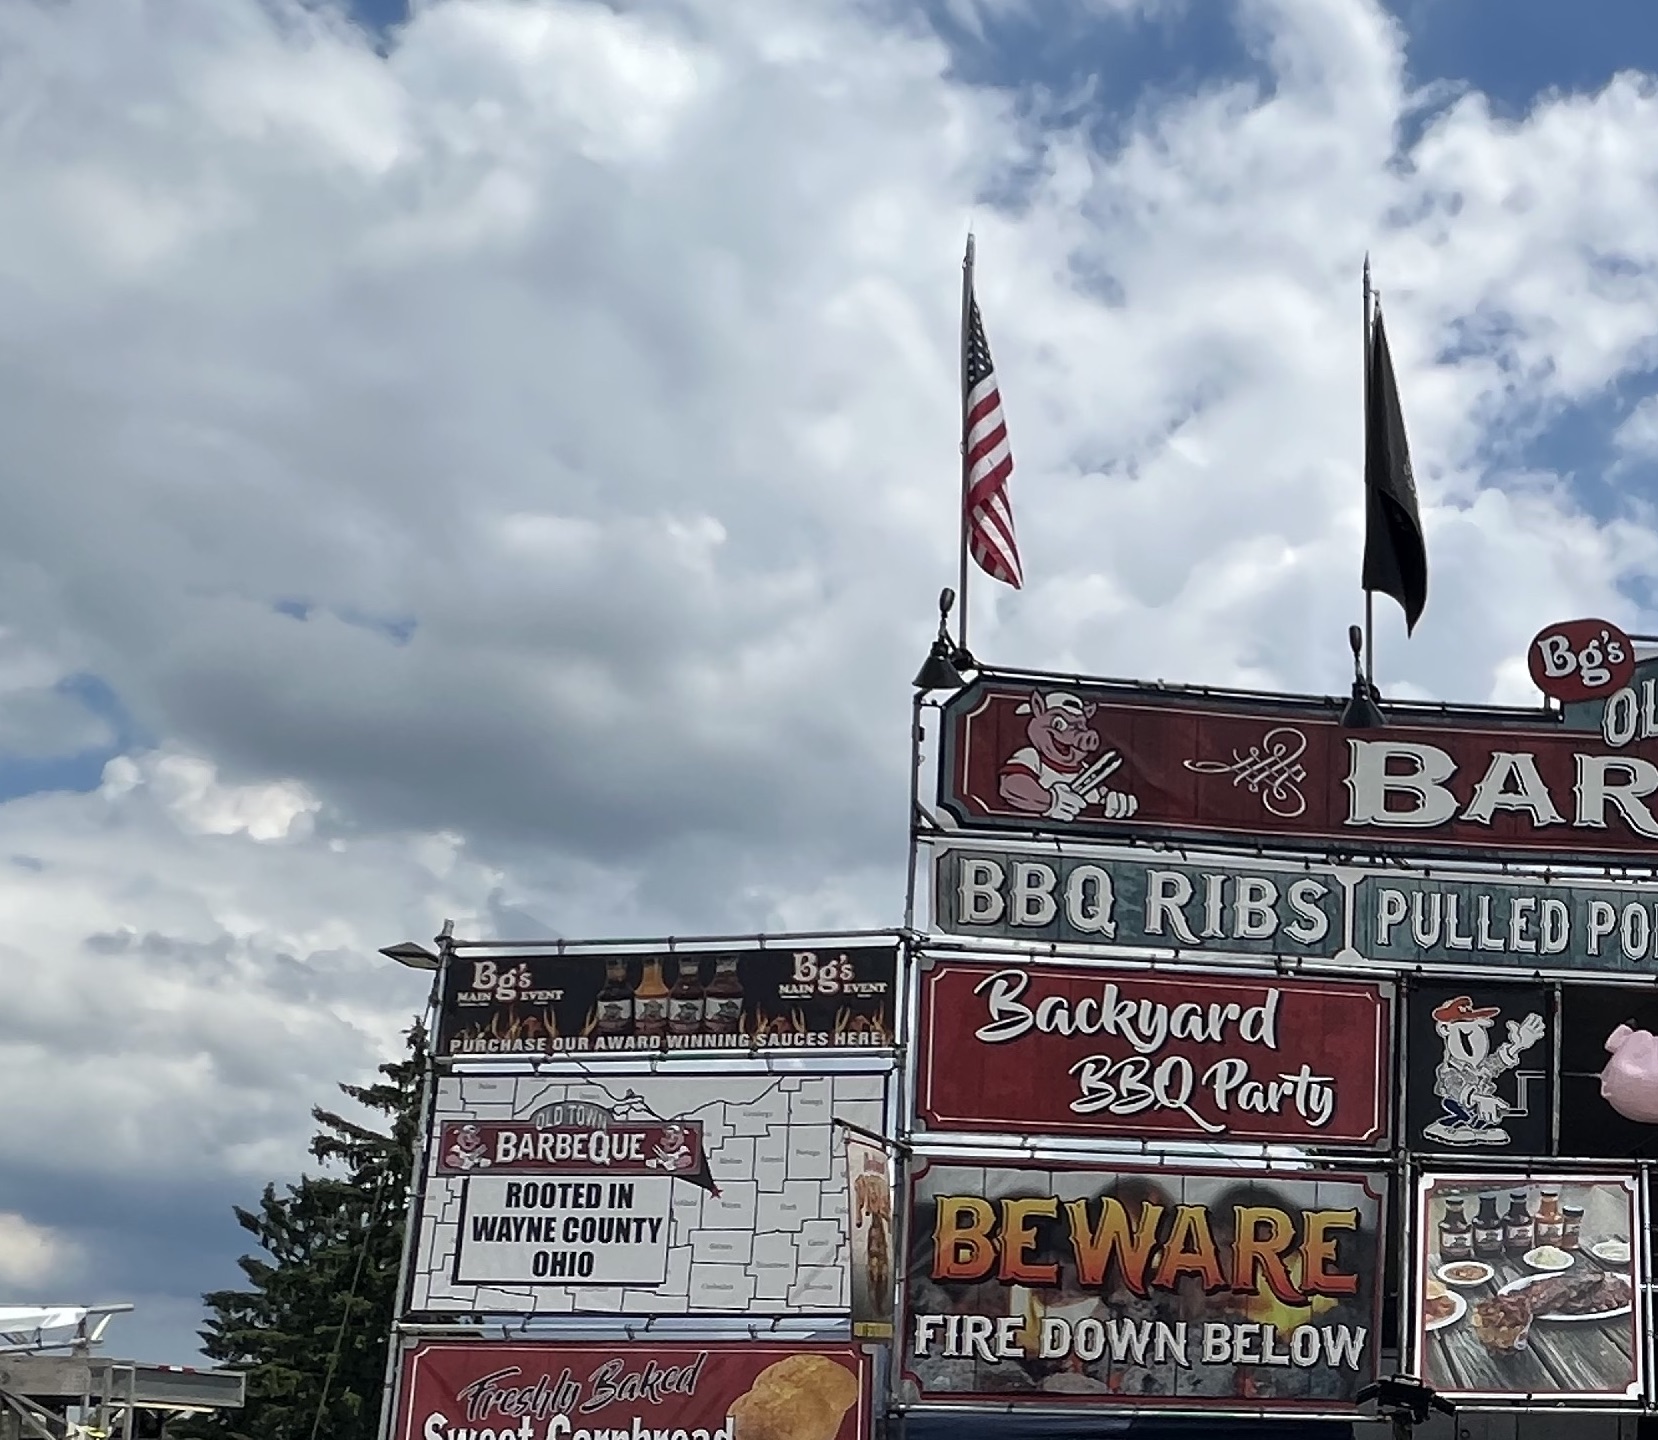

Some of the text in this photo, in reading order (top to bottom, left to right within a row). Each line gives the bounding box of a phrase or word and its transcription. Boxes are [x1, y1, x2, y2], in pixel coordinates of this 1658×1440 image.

[1537, 630, 1625, 687] Bg's
[957, 857, 1332, 947] BBQ RIBS
[1376, 886, 1571, 957] PULLED
[472, 960, 532, 1001] Bg's
[778, 981, 888, 995] MAIN EVENT
[791, 951, 855, 994] Bg's
[457, 989, 565, 1002] MAIN EVENT
[973, 968, 1280, 1054] Backyard
[450, 1036, 547, 1053] PURCHASE
[551, 1035, 589, 1052] OUR
[593, 1035, 660, 1051] AWARD
[666, 1033, 750, 1050] WINNING
[755, 1032, 829, 1048] SAUCES
[1067, 1054, 1336, 1134] BBQ Party
[534, 1104, 607, 1131] OLD TOWN
[495, 1130, 646, 1167] BARBEQUE
[504, 1181, 635, 1209] ROOTED IN
[471, 1215, 664, 1244] WAYNE COUNTY
[531, 1250, 595, 1278] OHIO
[930, 1194, 1362, 1308] BEWARE
[914, 1313, 1368, 1371] FIRE DOWN BELOW
[456, 1349, 709, 1422] Freshly Baked
